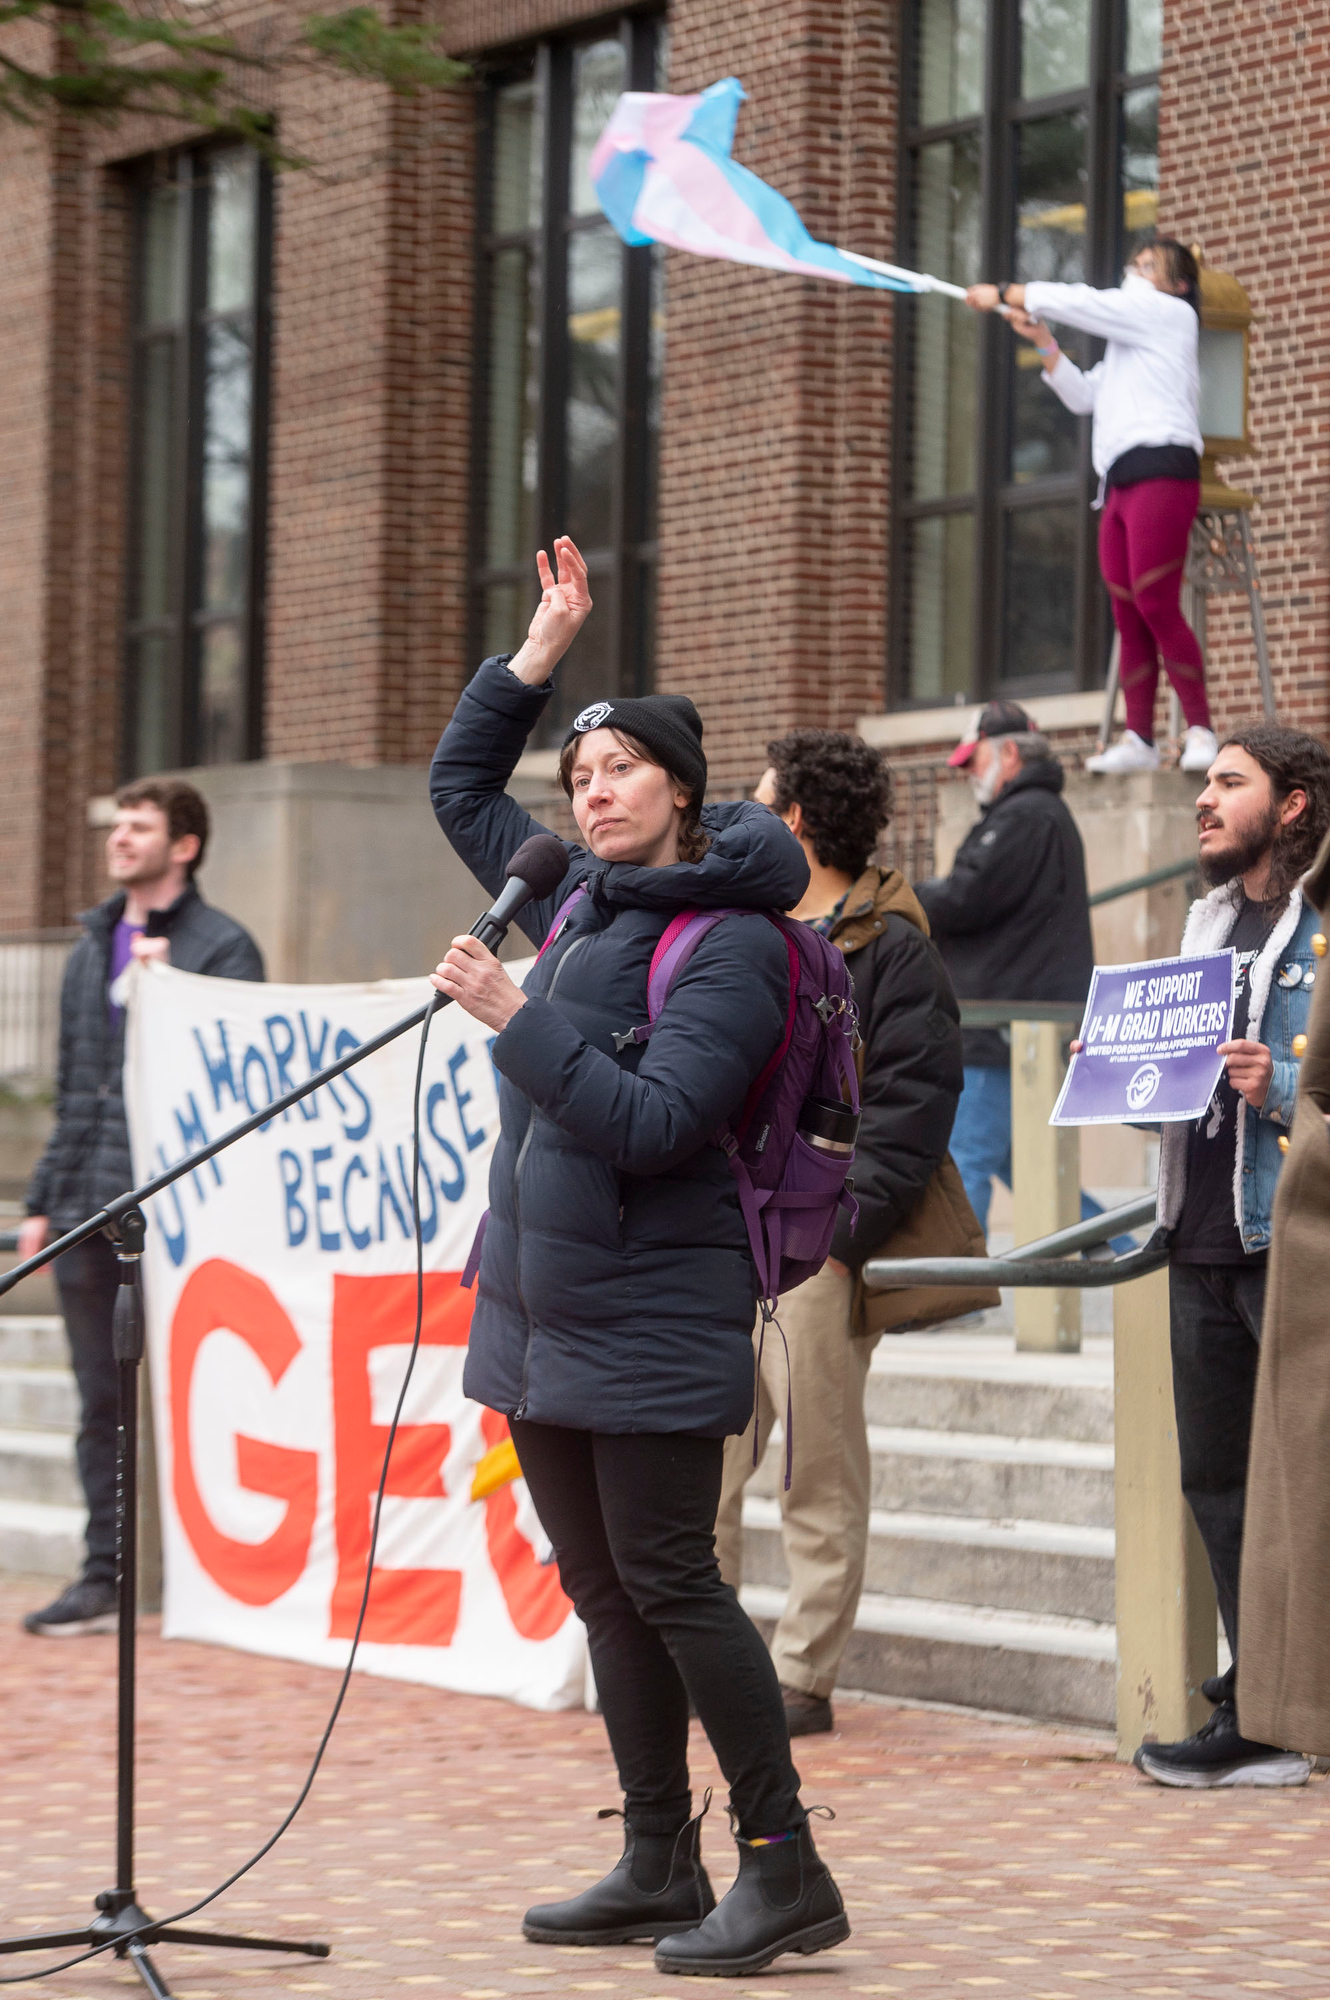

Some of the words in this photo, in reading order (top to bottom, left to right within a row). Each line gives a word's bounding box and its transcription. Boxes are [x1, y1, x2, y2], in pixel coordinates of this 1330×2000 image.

[1123, 980, 1146, 1009] WE
[1145, 971, 1204, 1007] SUPPORT
[1087, 1014, 1121, 1044] U-M
[1119, 1010, 1160, 1042] GRAD
[1161, 1001, 1227, 1037] WORKERS
[1086, 1045, 1112, 1056] UNITED
[1111, 1044, 1128, 1055] FOR
[1127, 1042, 1155, 1055] DIGNITY
[1153, 1041, 1169, 1052] AND
[1168, 1034, 1219, 1051] AFFORDABILITY
[193, 1010, 372, 1142] WORKS
[280, 1043, 485, 1251] BECAUSE
